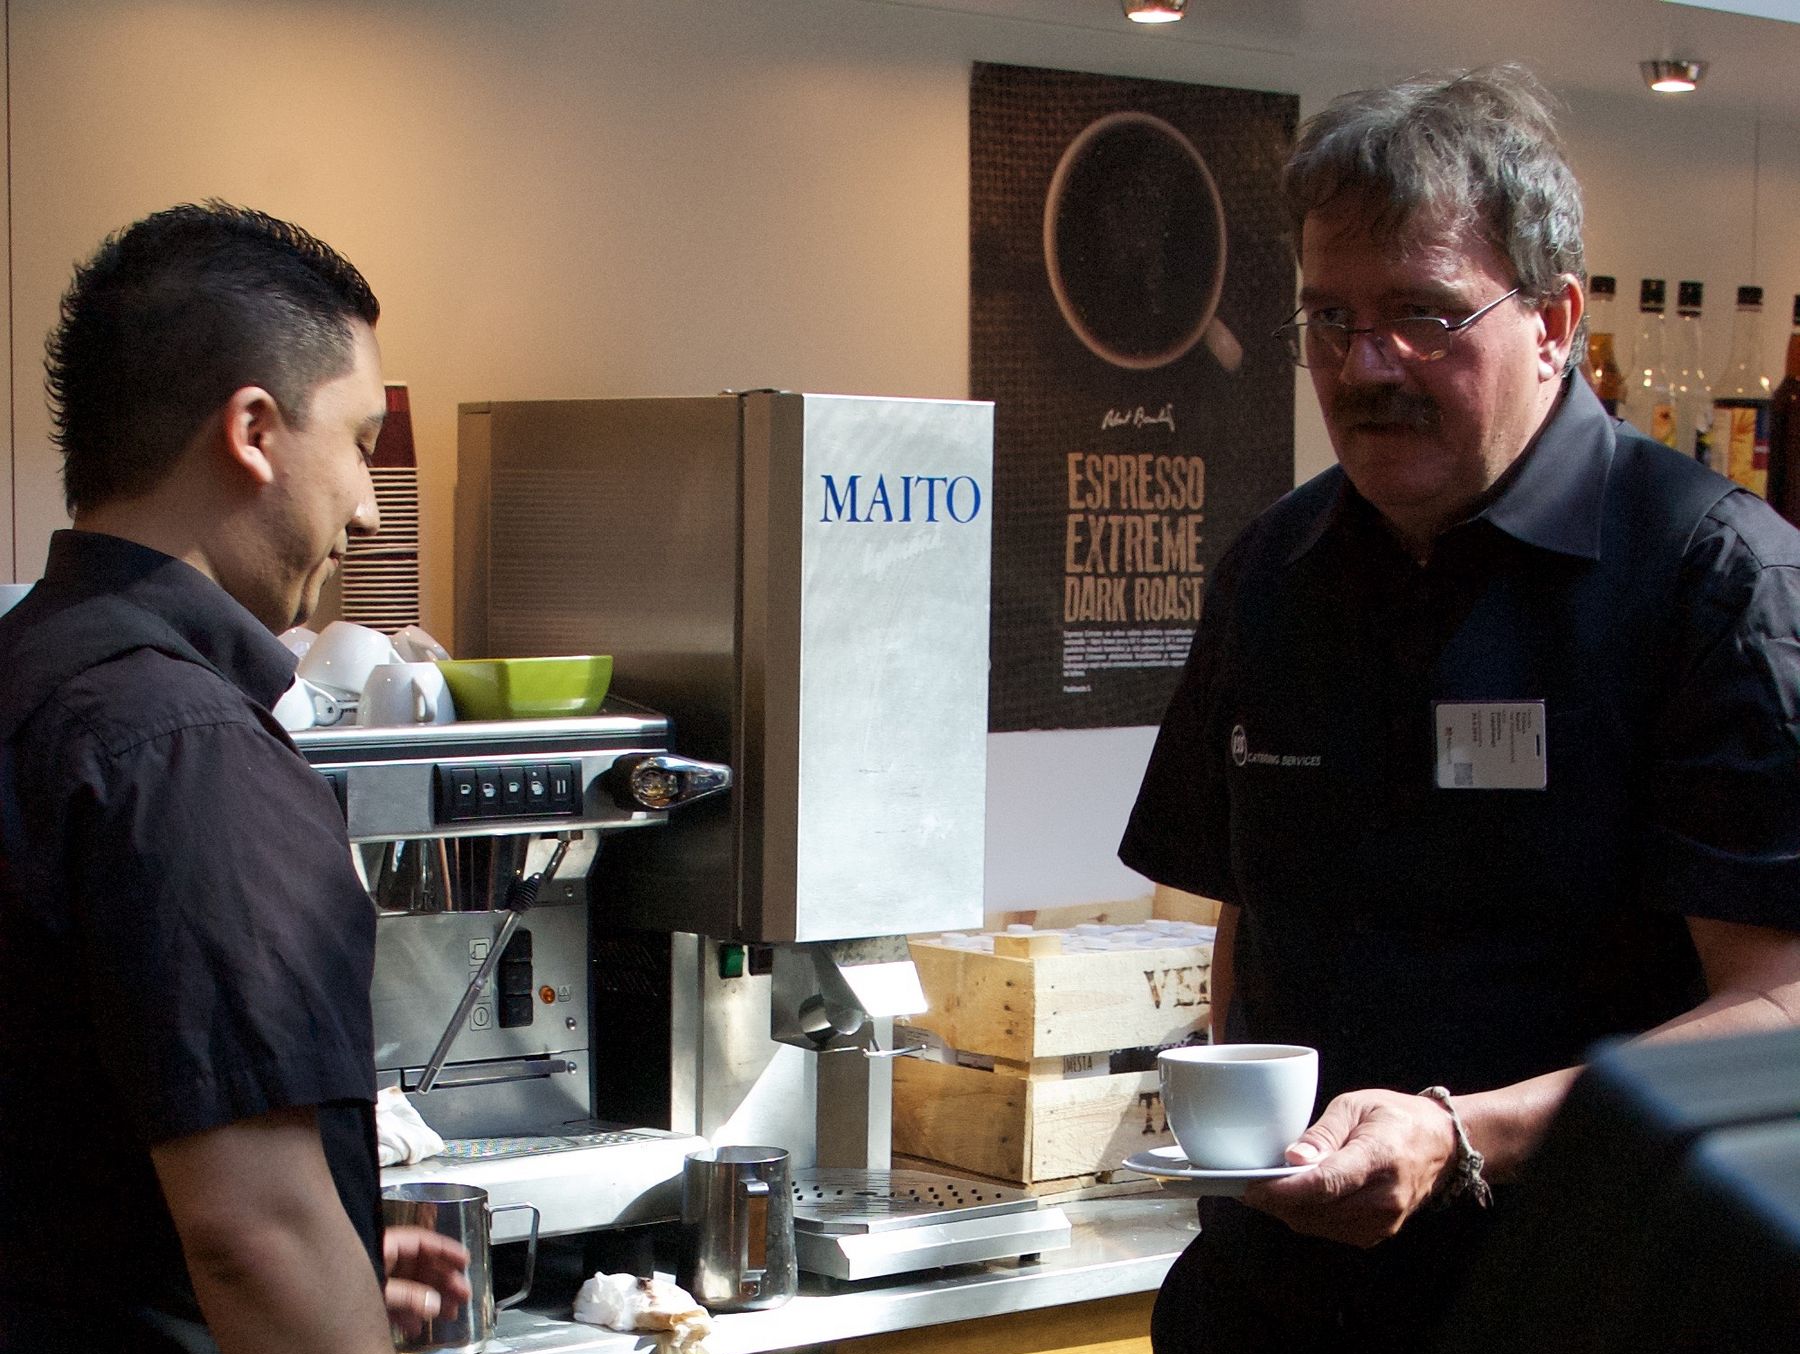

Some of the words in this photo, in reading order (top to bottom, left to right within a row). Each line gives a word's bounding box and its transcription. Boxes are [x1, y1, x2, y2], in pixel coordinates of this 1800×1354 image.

[820, 473, 981, 523] MAITO
[1067, 452, 1205, 510] ESPRESSO
[1065, 514, 1204, 573] EXTREME
[1064, 575, 1127, 622] DARK
[1134, 575, 1204, 622] ROAST
